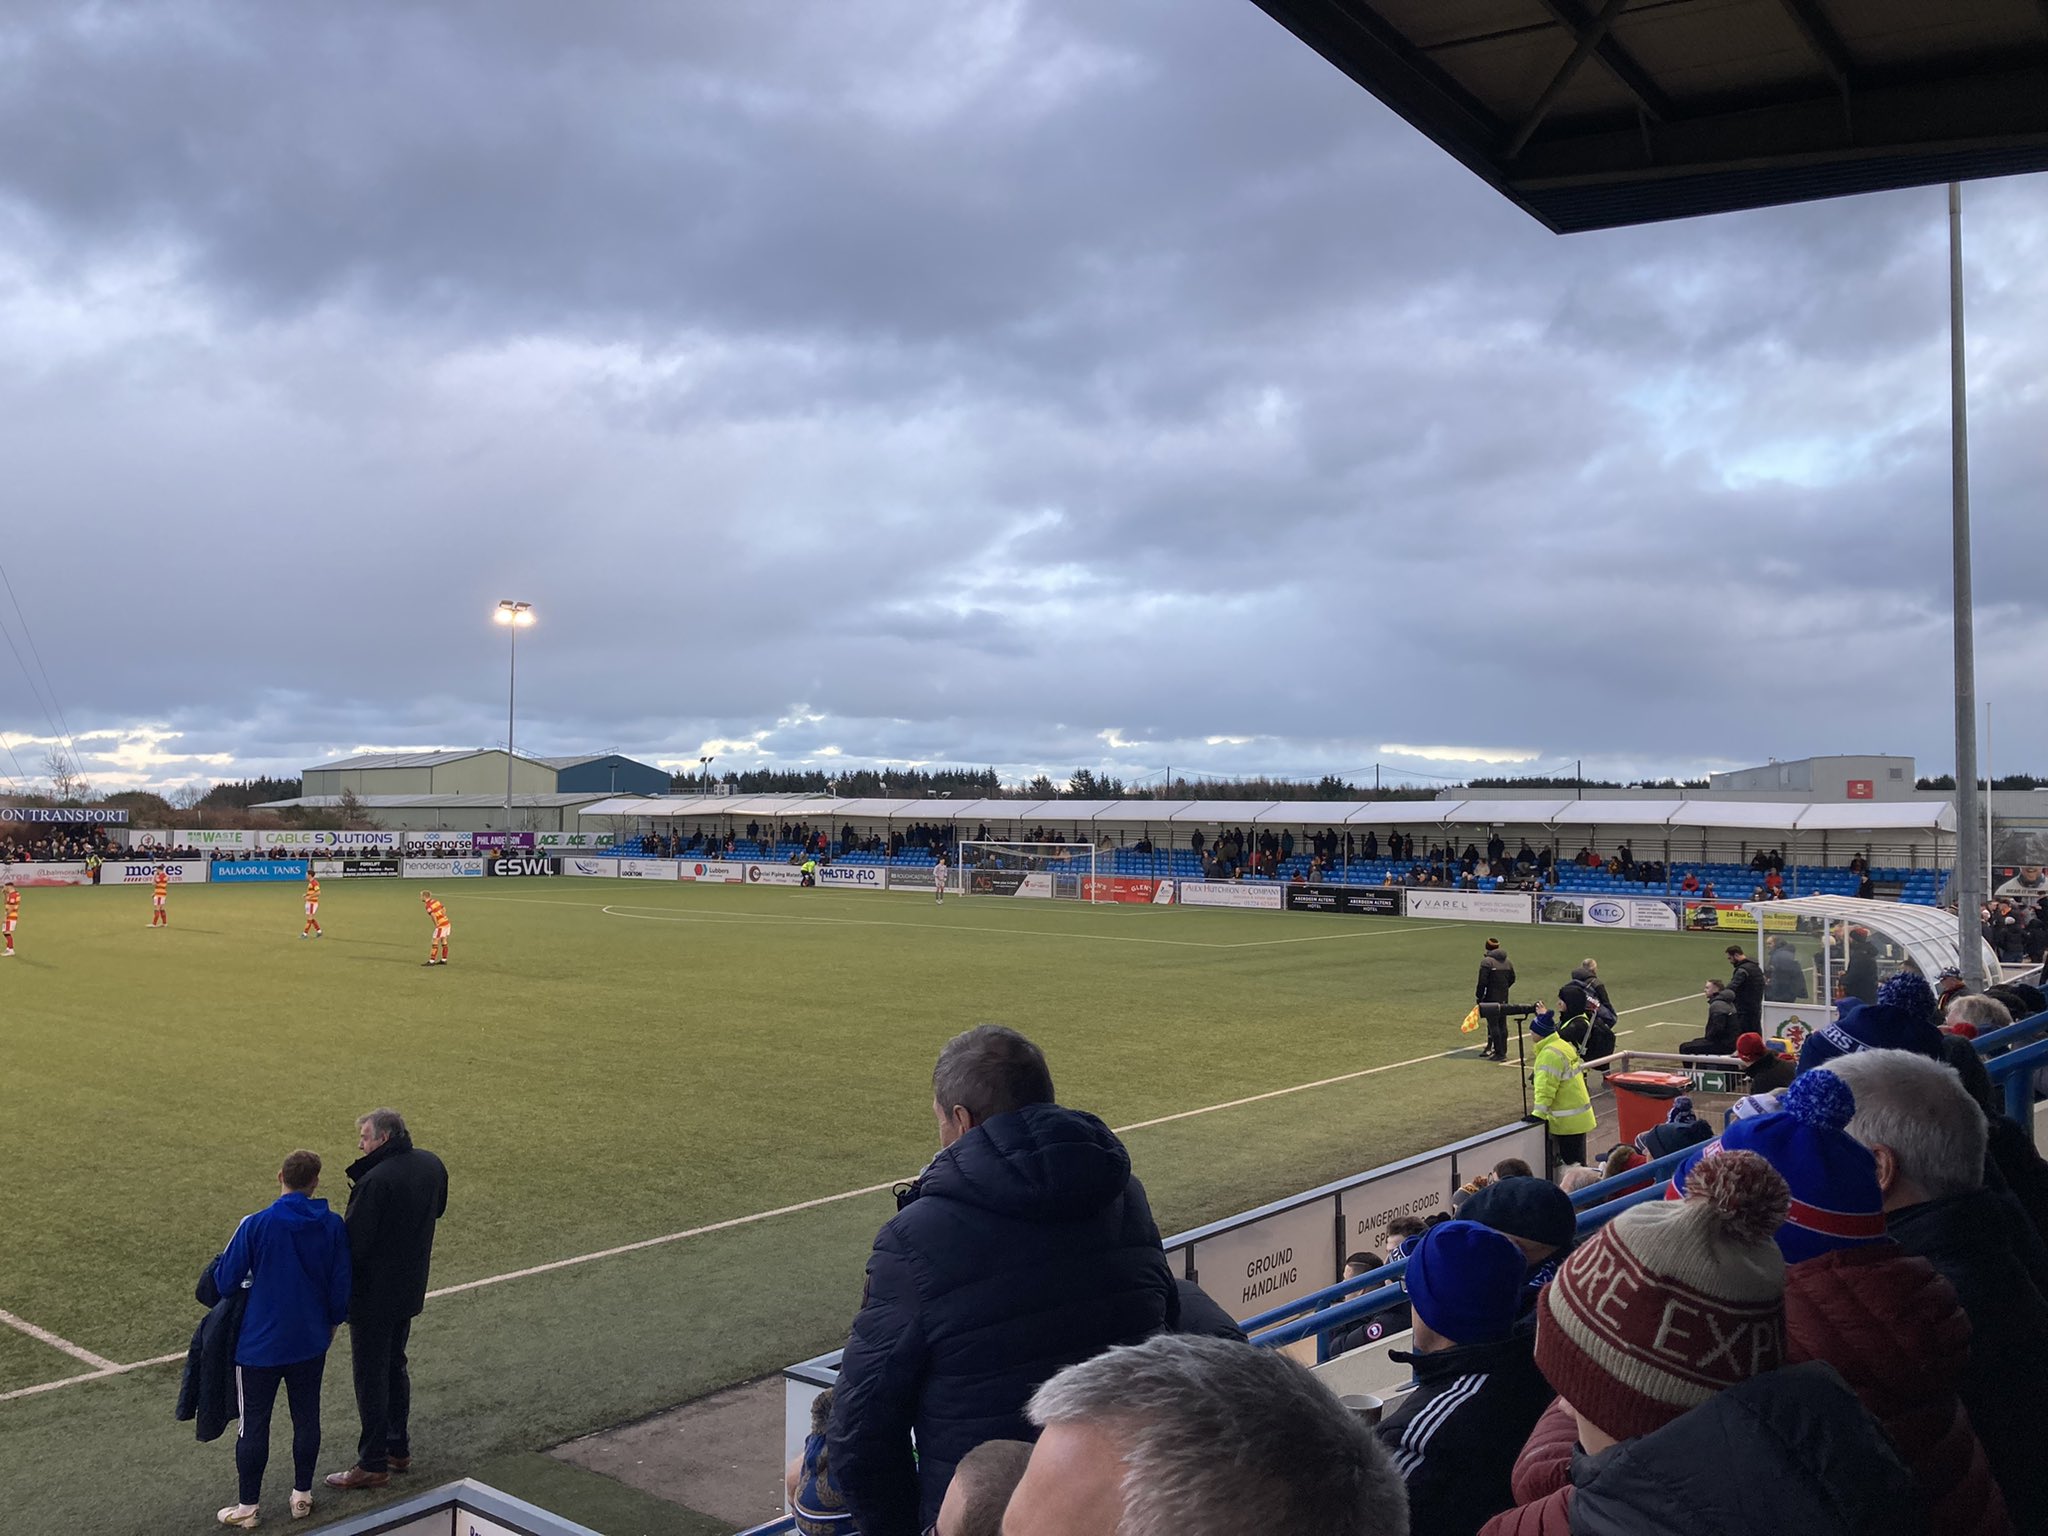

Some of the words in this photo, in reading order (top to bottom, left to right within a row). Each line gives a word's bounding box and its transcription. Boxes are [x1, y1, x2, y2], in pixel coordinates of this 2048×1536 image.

[1, 809, 25, 821] ON
[29, 809, 126, 822] TRANSPORT
[266, 833, 310, 844] CABLE
[315, 832, 393, 846] SOLUTIONS
[476, 836, 490, 845] PHIL
[491, 836, 520, 845] ANDESON
[538, 835, 556, 846] ACE
[125, 863, 183, 877] moaes
[218, 866, 270, 876] BALMORAL
[273, 866, 301, 875] TANKS
[405, 860, 452, 870] henderson
[1424, 900, 1469, 908] VAREL
[1358, 1203, 1410, 1234] DANGEROUS
[1412, 1191, 1440, 1213] GOODS
[1247, 1247, 1293, 1278] GROUND
[1242, 1267, 1297, 1303] HANDLING
